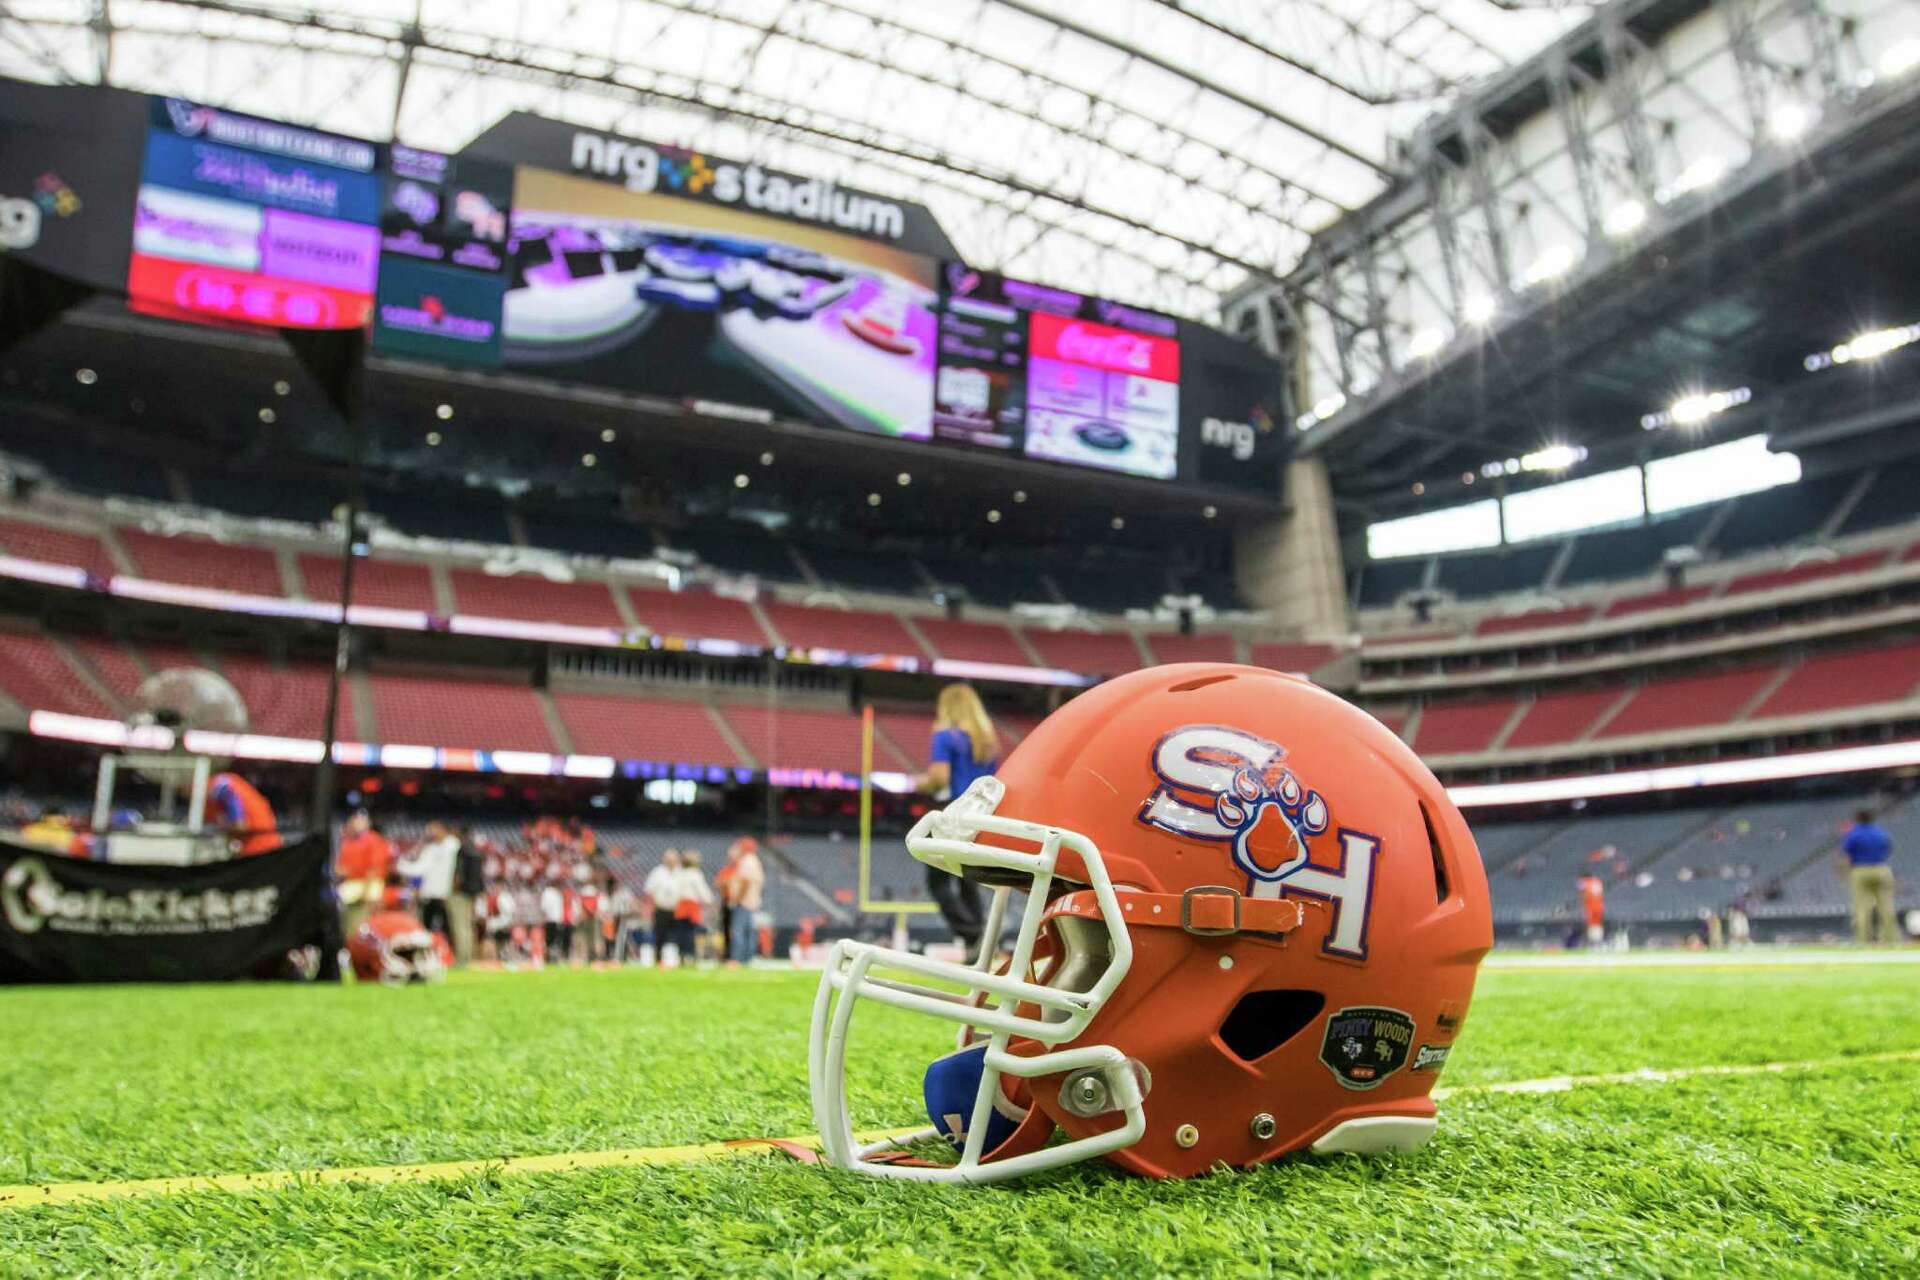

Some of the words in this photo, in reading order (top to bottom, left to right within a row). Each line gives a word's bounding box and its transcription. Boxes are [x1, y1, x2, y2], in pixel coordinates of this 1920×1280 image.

[571, 132, 661, 193] nrg
[713, 165, 904, 239] stadium
[1202, 416, 1255, 460] nrg
[1374, 1019, 1410, 1045] WOODS
